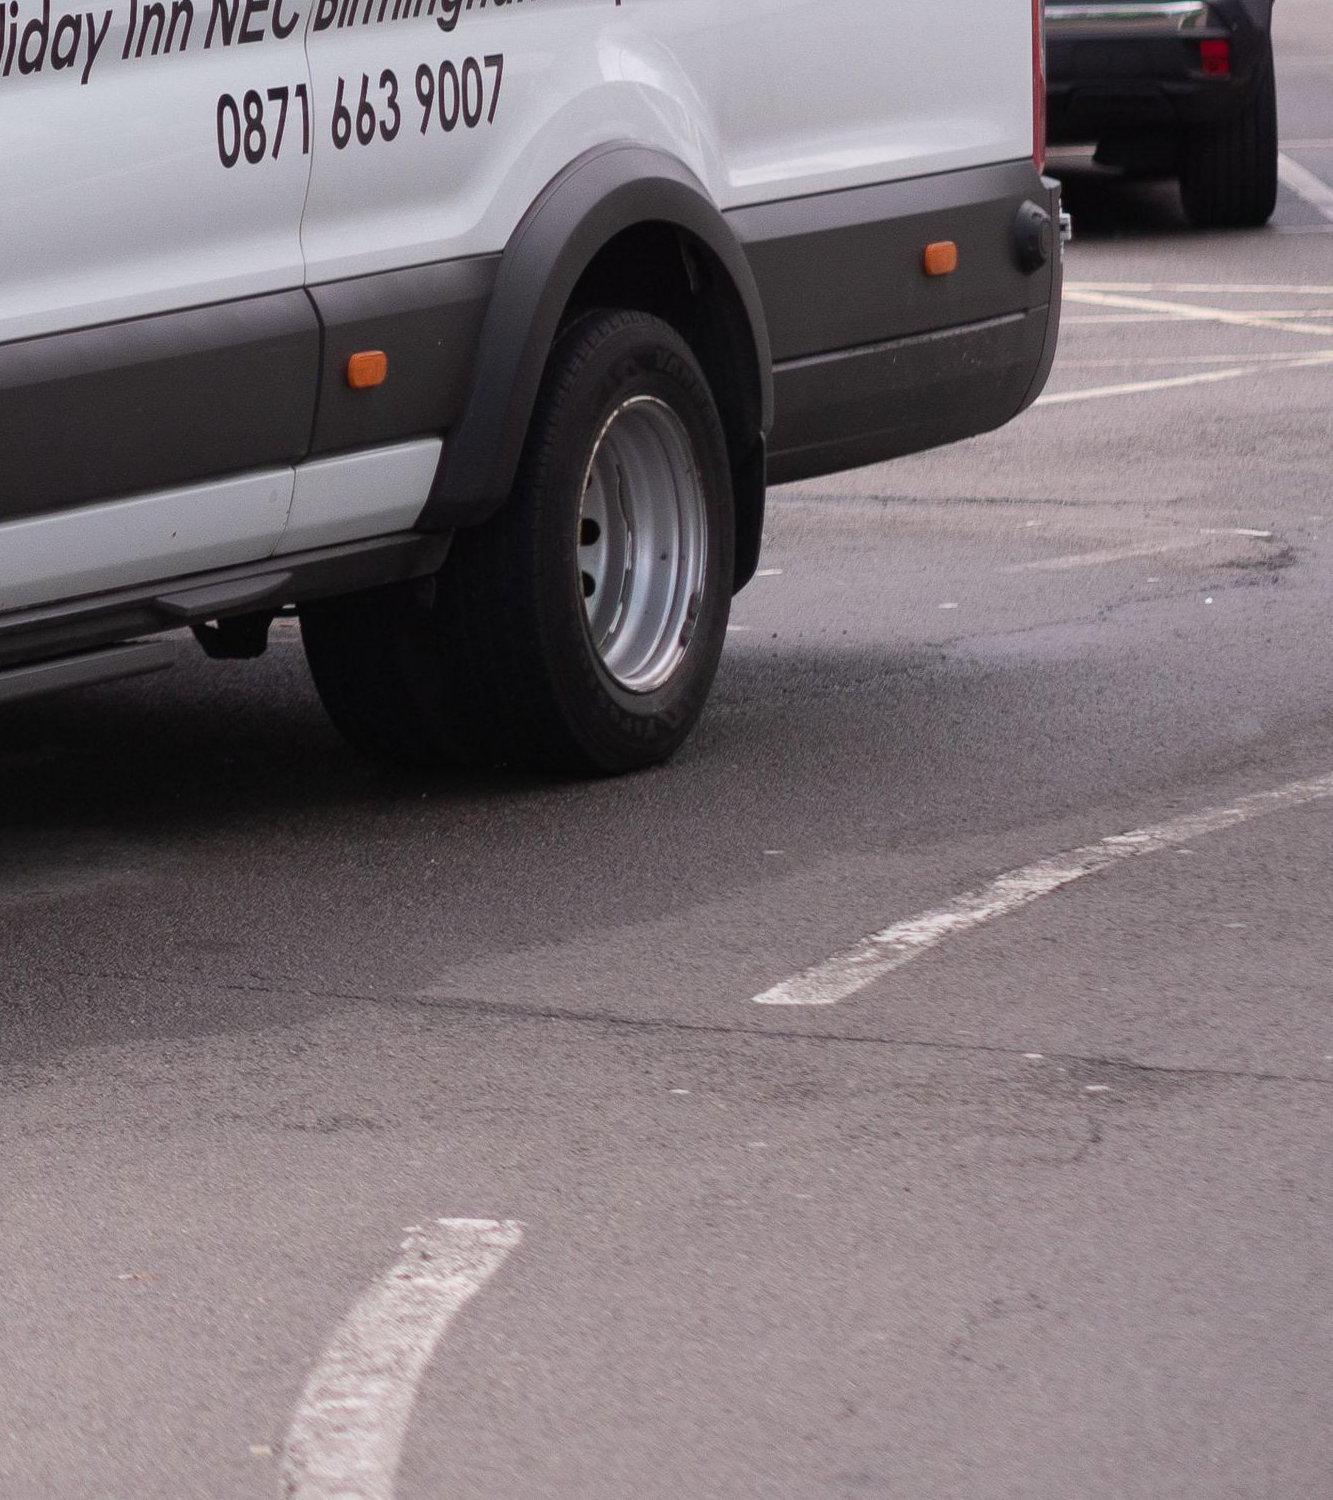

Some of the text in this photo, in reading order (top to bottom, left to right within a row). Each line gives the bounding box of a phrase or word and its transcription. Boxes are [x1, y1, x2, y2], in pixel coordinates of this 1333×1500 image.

[216, 54, 505, 169] 0871 663 9007
